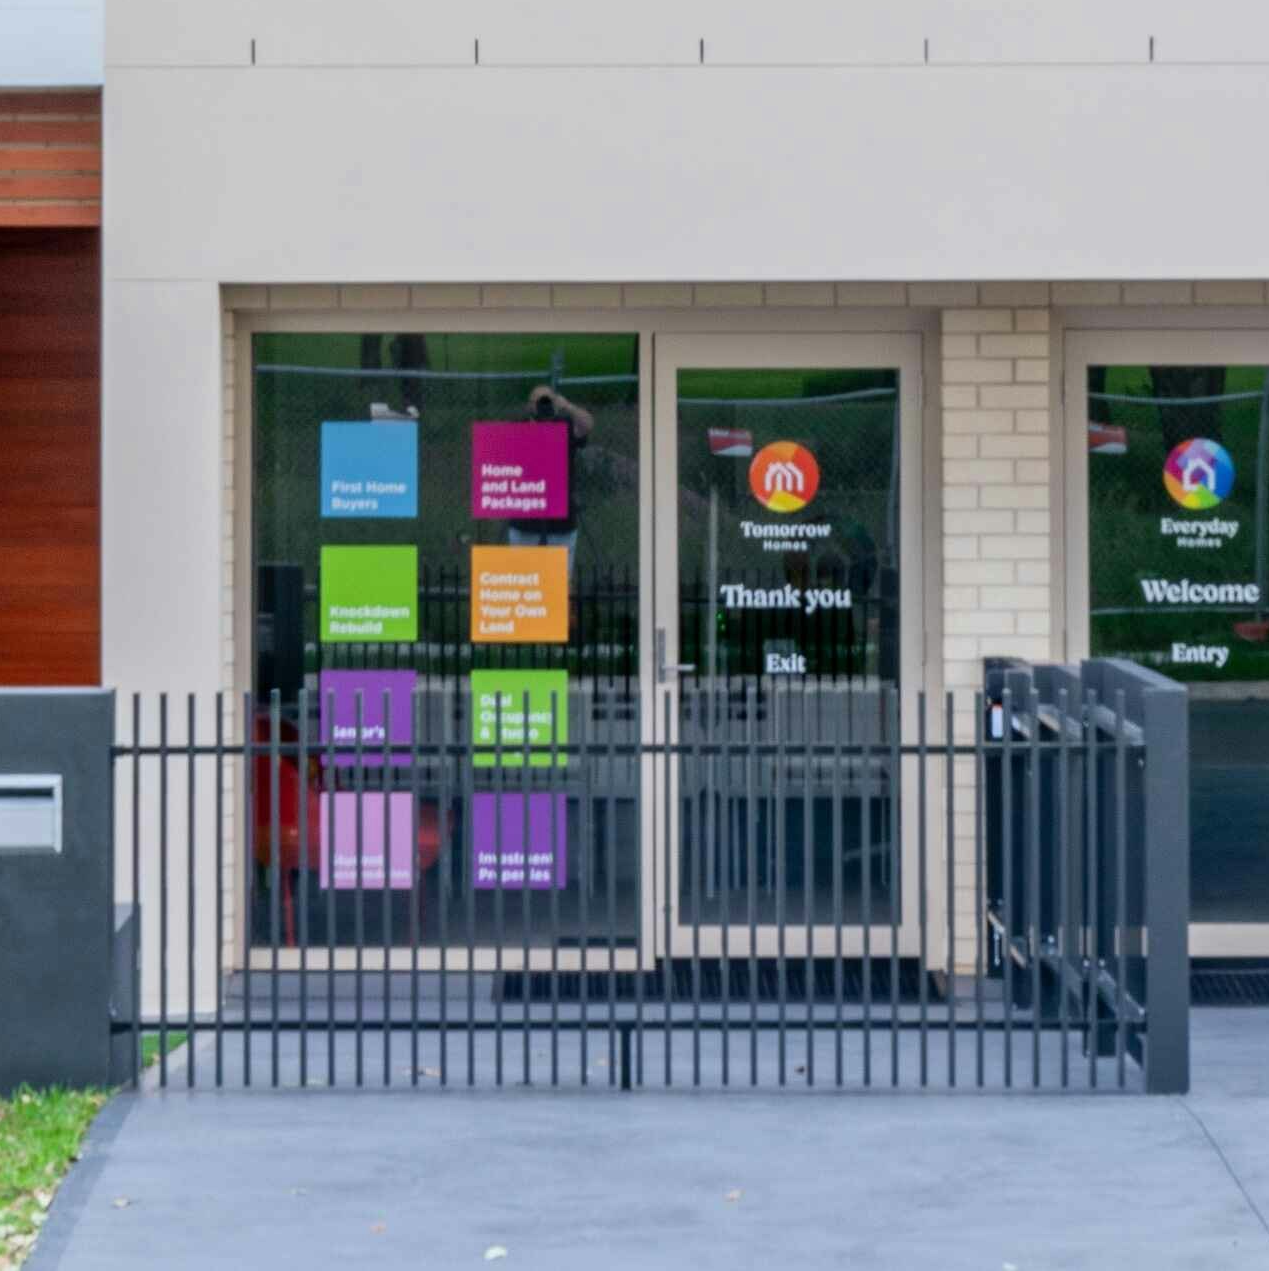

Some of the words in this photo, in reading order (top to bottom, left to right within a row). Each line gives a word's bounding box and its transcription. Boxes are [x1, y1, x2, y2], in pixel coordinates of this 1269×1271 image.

[481, 464, 523, 477] Home
[331, 481, 363, 494] First
[366, 482, 407, 494] Home
[481, 480, 508, 493] and
[511, 480, 546, 493] Land
[331, 497, 378, 511] Buyers
[481, 496, 547, 511] Packages
[740, 521, 831, 538] Tomorrow
[1160, 518, 1239, 538] Everyday
[763, 540, 808, 551] Homes
[1177, 537, 1222, 548] Homes
[480, 572, 540, 586] Contract
[480, 589, 519, 602] Home
[522, 591, 543, 602] on
[1141, 579, 1260, 604] Welcome
[720, 584, 801, 608] Thank
[805, 588, 852, 615] you
[329, 605, 410, 618] Knockdown
[481, 606, 511, 618] Your
[515, 606, 547, 618] Own
[329, 621, 383, 634] Rebuild
[480, 621, 515, 634] Land
[1172, 643, 1229, 668] Entry
[766, 653, 806, 673] Exit
